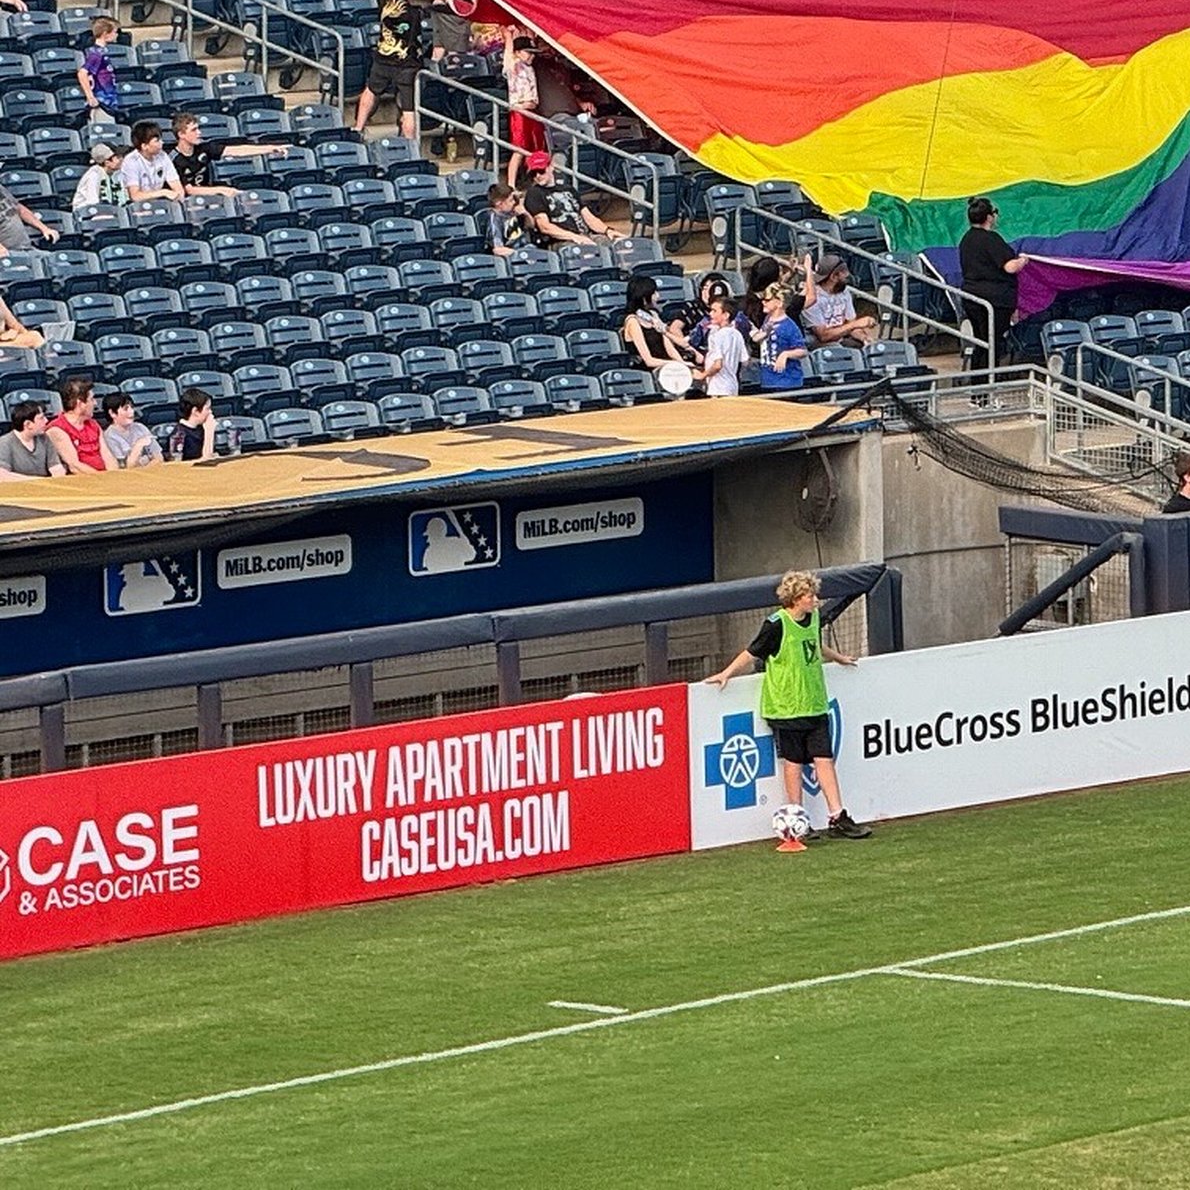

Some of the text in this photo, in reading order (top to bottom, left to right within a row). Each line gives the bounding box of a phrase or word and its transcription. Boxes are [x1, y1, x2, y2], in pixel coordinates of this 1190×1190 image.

[522, 508, 637, 540] MiLB.com/shop
[224, 546, 345, 579] MiLB.com/shop
[863, 708, 1021, 760] BlueCross
[257, 706, 665, 828] LUXURY APARTMENT LIVING
[17, 804, 199, 887] CASE
[361, 791, 570, 883] CASEUSA.COM
[18, 865, 201, 915] & ASSOCIATES
